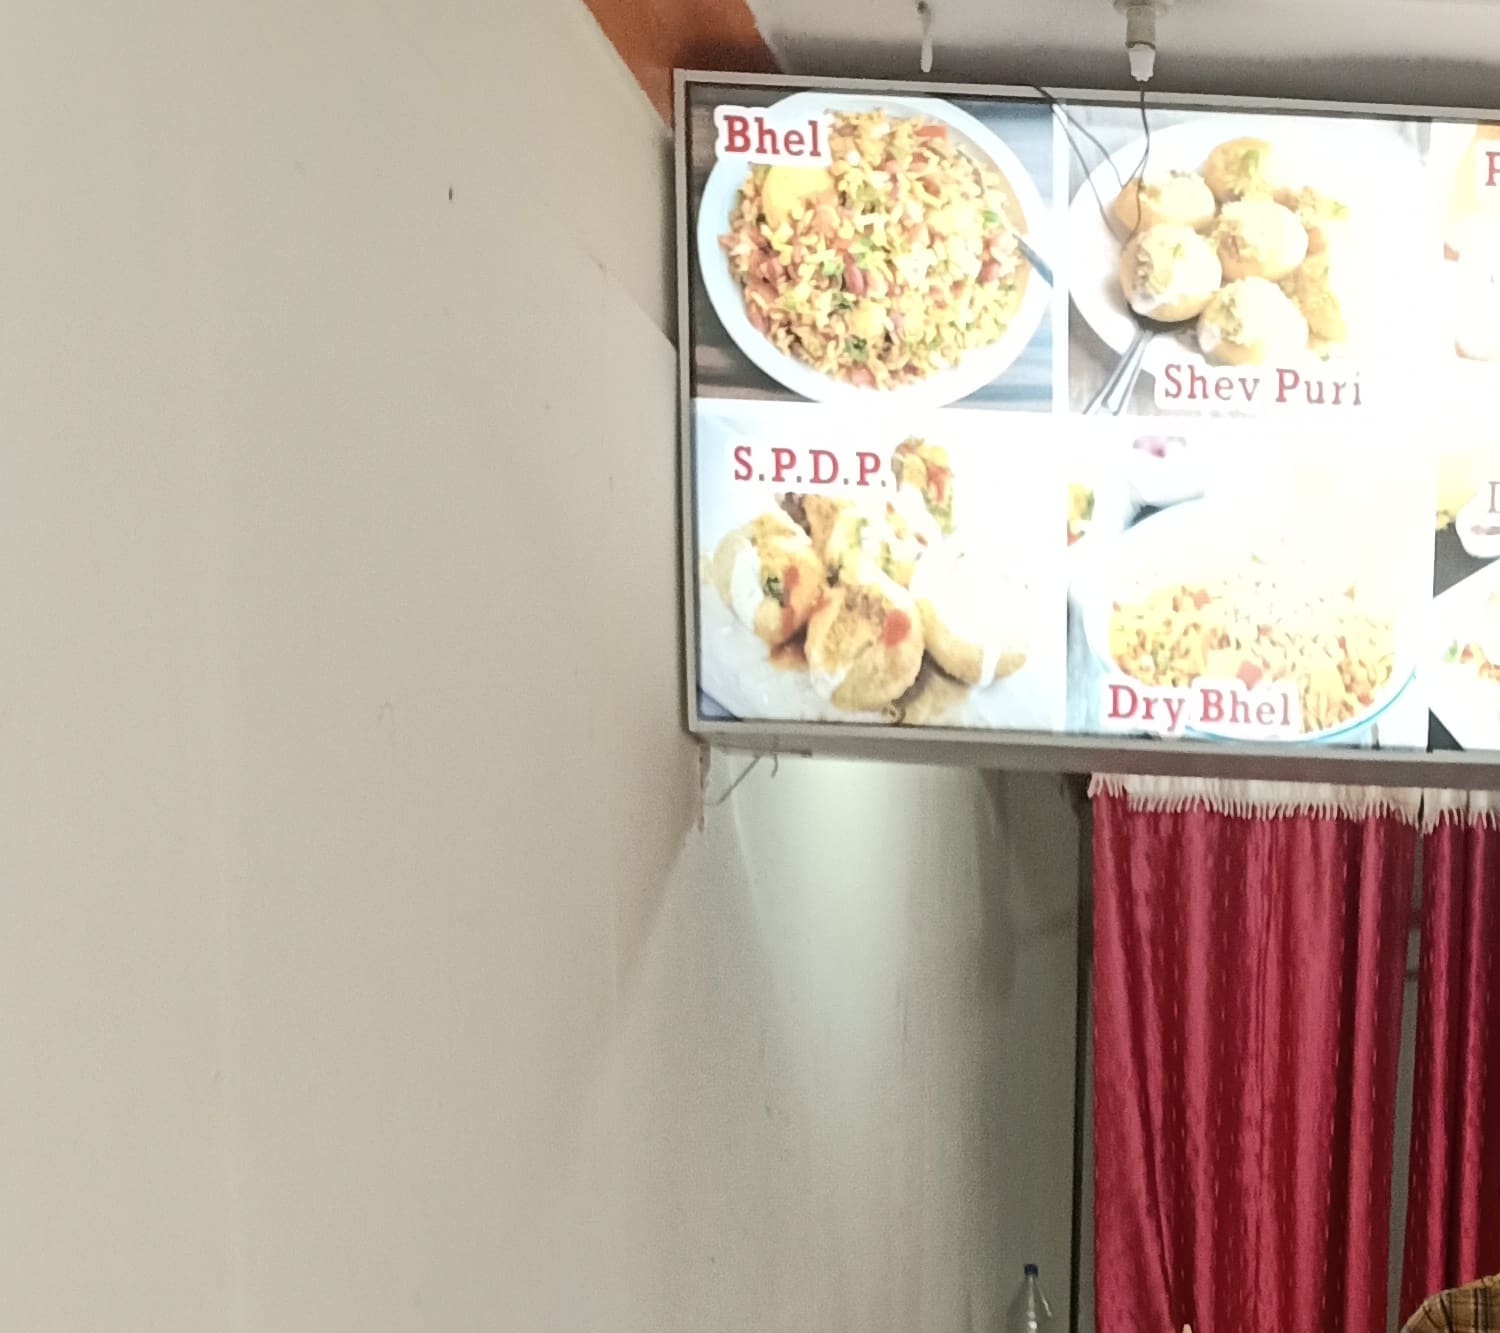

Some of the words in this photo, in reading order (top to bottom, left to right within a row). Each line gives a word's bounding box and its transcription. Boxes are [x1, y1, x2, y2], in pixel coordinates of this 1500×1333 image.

[723, 114, 822, 157] Bhel
[1163, 364, 1262, 403] Shev
[1275, 368, 1362, 406] Puri
[733, 446, 888, 488] S.P.D.P.
[1108, 684, 1186, 730] Dry
[1200, 686, 1292, 726] Bhel
